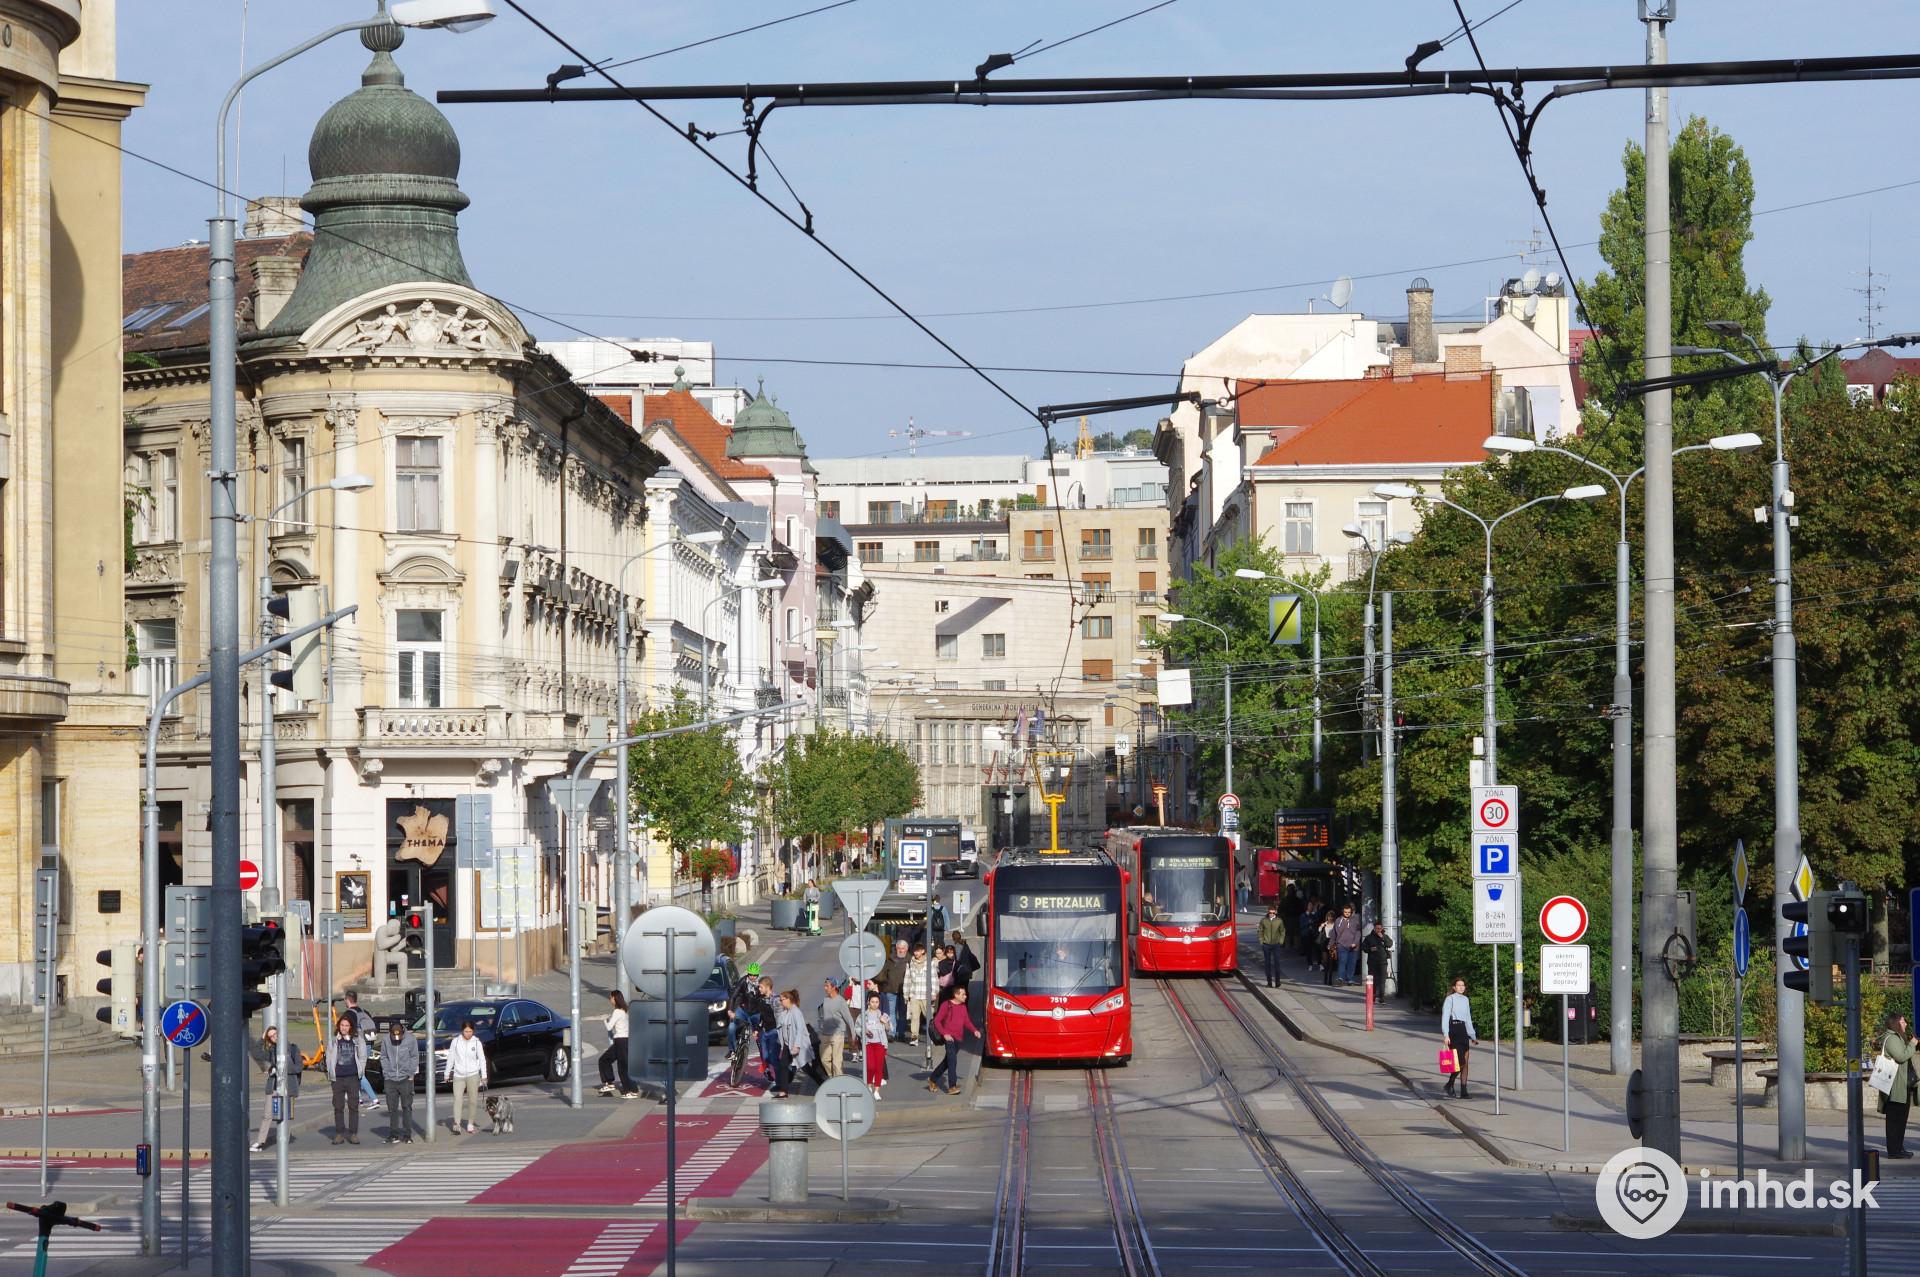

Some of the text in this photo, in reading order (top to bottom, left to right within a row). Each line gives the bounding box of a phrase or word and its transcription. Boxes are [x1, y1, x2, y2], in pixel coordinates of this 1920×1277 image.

[1117, 740, 1127, 750] 30
[1486, 806, 1504, 820] 30
[926, 829, 933, 837] B
[1158, 857, 1165, 868] 4
[1487, 848, 1504, 871] P
[1020, 895, 1029, 909] 3
[1050, 996, 1068, 1004] 7519
